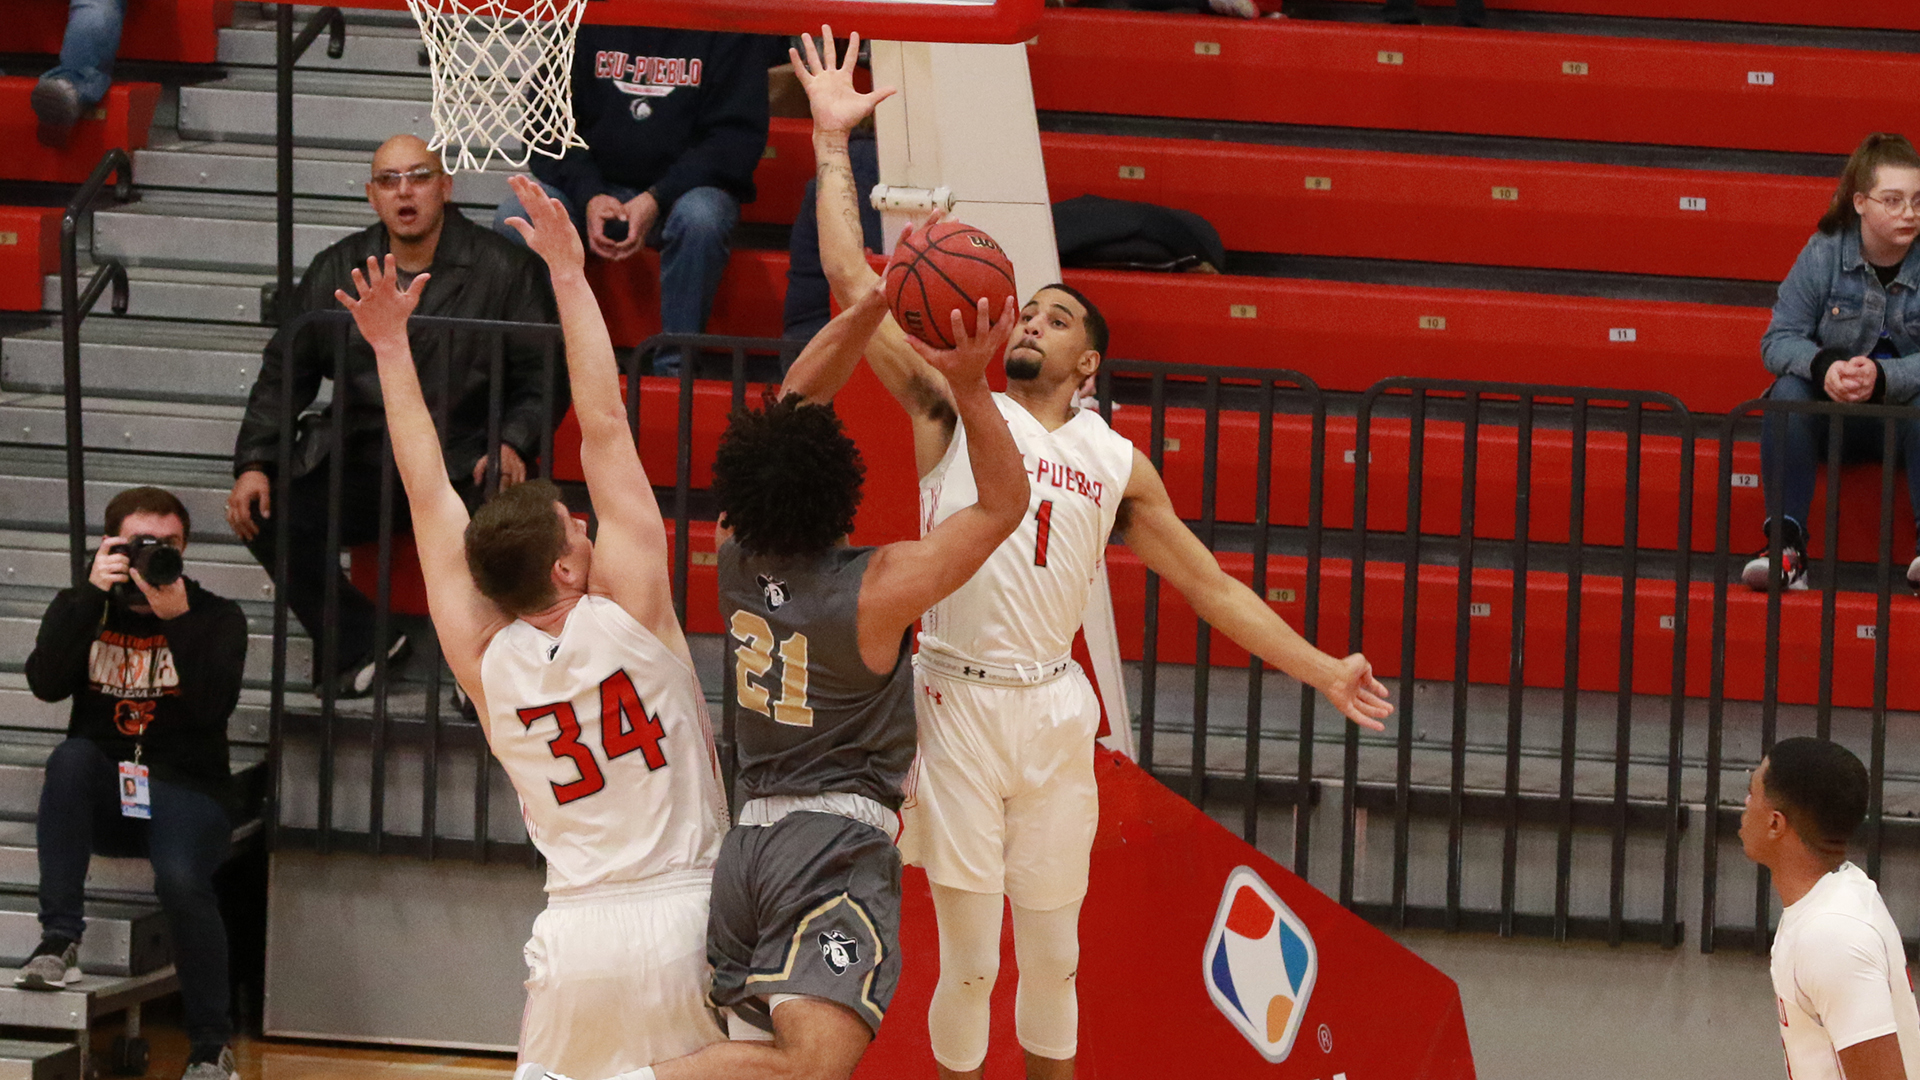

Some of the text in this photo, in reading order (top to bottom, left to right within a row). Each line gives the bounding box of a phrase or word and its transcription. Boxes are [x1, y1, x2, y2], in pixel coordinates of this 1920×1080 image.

[1570, 64, 1581, 73] 10
[1755, 74, 1765, 82] 11
[1500, 189, 1511, 198] 10
[1687, 199, 1697, 208] 11
[1427, 319, 1438, 328] 10
[1617, 330, 1627, 338] 11
[1739, 476, 1751, 485] 12
[1034, 499, 1053, 568] 1
[1276, 591, 1288, 600] 10
[1471, 605, 1482, 614] 11
[1864, 628, 1876, 637] 13
[730, 609, 813, 727] 21
[516, 668, 668, 806] 34
